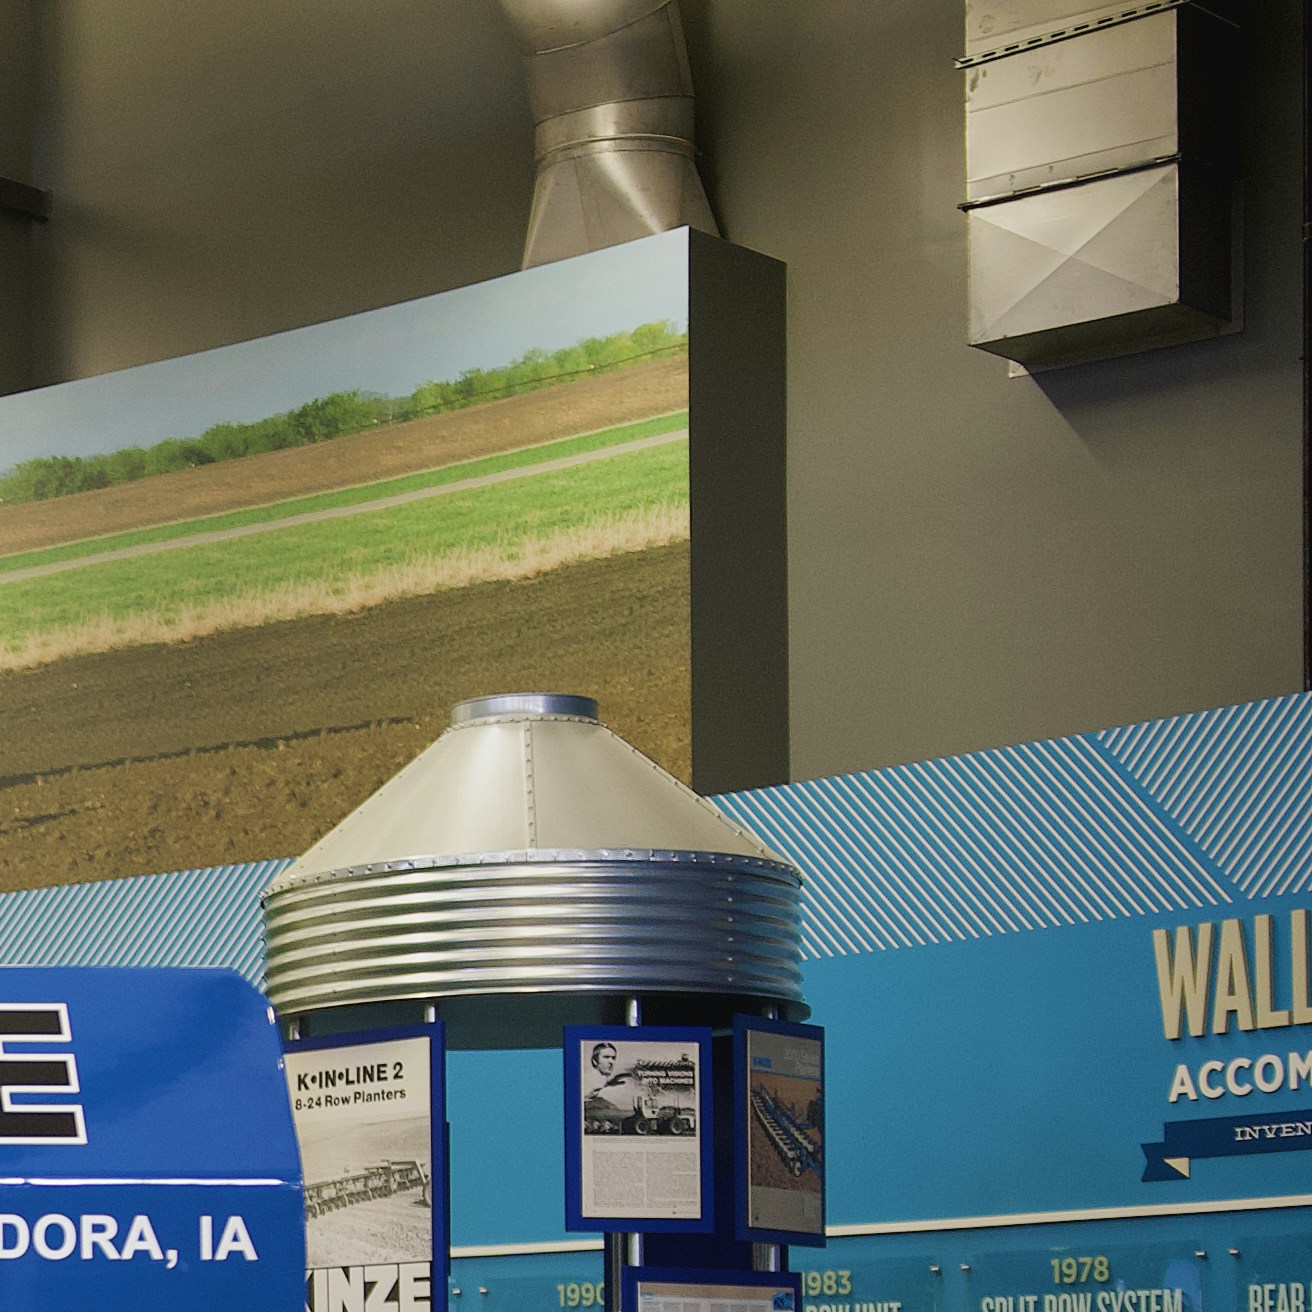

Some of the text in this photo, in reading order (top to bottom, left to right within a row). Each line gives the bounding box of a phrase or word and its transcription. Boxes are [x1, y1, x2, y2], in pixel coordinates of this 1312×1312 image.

[1152, 909, 1312, 1040] WALL
[393, 1061, 404, 1080] 2
[295, 1088, 407, 1111] 8-24 Row Planters
[199, 1214, 259, 1261] IA
[1050, 1255, 1110, 1284] 1978
